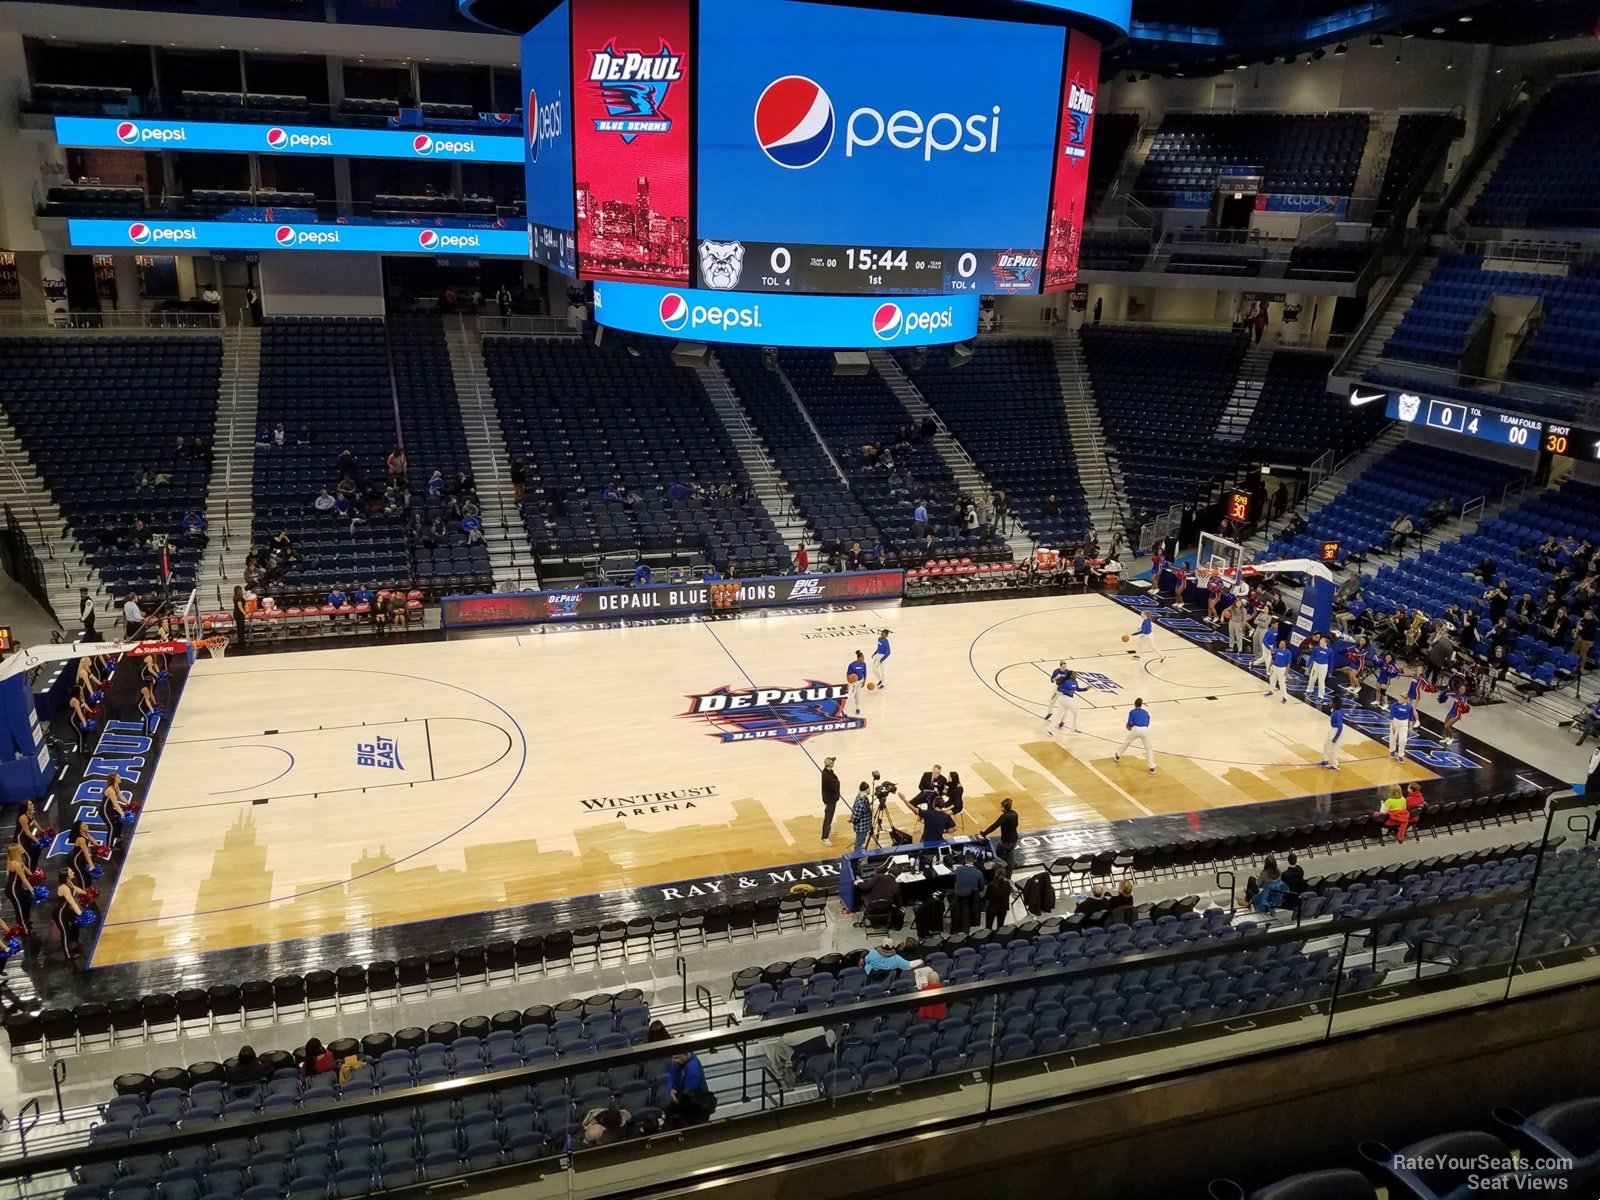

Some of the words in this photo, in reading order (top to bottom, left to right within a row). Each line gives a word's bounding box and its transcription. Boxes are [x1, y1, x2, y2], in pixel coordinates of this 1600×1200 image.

[538, 89, 562, 150] pepsi
[599, 120, 624, 131] BLUE
[627, 120, 667, 132] DEMONS
[141, 127, 186, 143] pepsi
[289, 132, 332, 148] pepsi
[845, 104, 1001, 162] pepsi
[435, 138, 475, 154] pepsi
[153, 226, 197, 242] pepsi
[299, 230, 340, 246] pepsi
[439, 233, 479, 248] pepsi
[770, 247, 791, 274] 0
[826, 258, 837, 268] 00
[846, 248, 908, 271] 15:44
[915, 260, 925, 270] 00
[957, 252, 977, 278] 0
[761, 276, 779, 286] TOL
[785, 278, 791, 287] 4
[869, 275, 883, 285] 1st
[951, 280, 967, 289] TOL
[970, 281, 976, 290] 4
[691, 304, 762, 331] pepsi
[904, 306, 952, 335] pepsi
[1440, 407, 1453, 425] 0
[1470, 407, 1482, 417] TOL
[1467, 417, 1478, 434] 4
[1500, 414, 1520, 426] TEAM
[1519, 418, 1542, 431] FOULS
[1549, 425, 1570, 436] SHOT
[1509, 426, 1527, 445] 00
[1546, 435, 1567, 454] 30
[790, 585, 825, 595] EAST
[795, 578, 819, 587] BIG
[598, 592, 661, 611] DEPAUL
[670, 589, 708, 606] BLUE
[732, 729, 778, 741] BLUE
[786, 721, 858, 735] DEMONS
[357, 743, 375, 767] BIG
[376, 735, 394, 769] EAST
[580, 785, 717, 810] WINTRUST
[616, 801, 697, 818] ARENA
[659, 880, 722, 901] RAY
[738, 876, 759, 889] &
